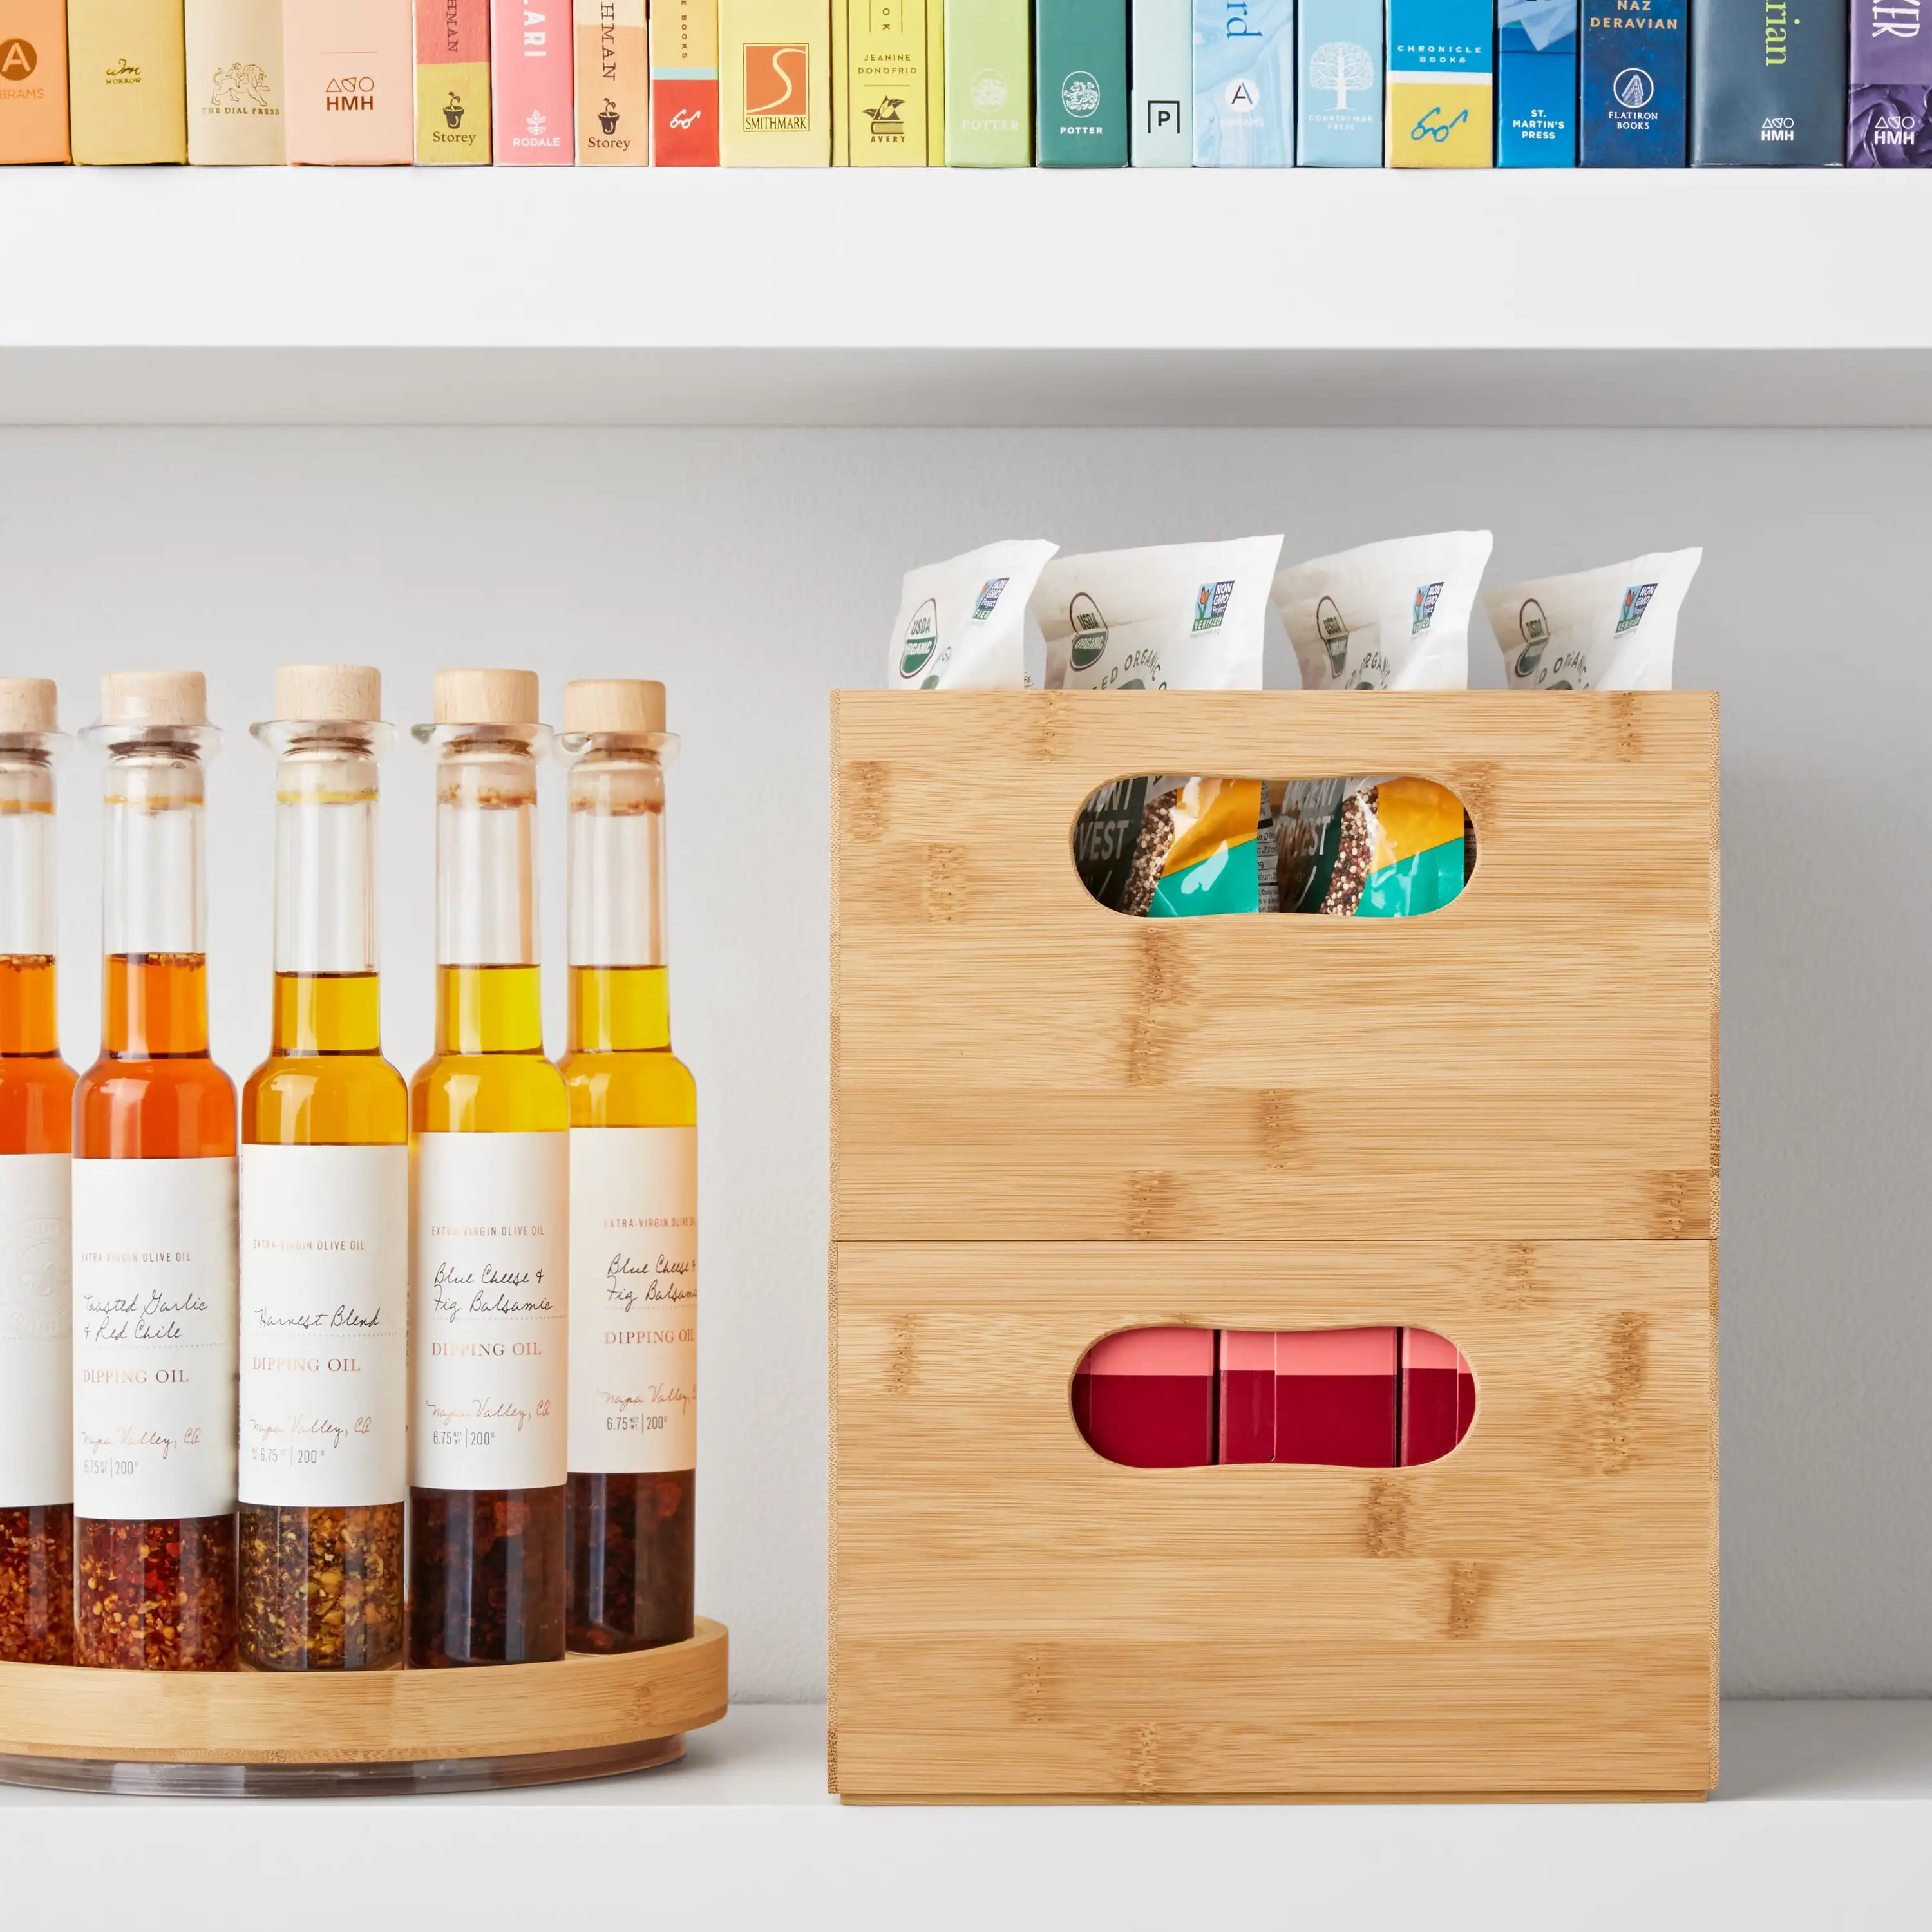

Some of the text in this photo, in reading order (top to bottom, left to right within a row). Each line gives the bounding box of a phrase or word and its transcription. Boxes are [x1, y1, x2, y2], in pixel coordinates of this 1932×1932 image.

[1617, 1, 1651, 11] NAZ
[523, 0, 547, 57] ARI
[1590, 17, 1678, 30] DERAVIAN
[1765, 0, 1801, 66] rian
[601, 1, 616, 80] HMAN
[1397, 44, 1482, 53] CHRONICLE
[858, 66, 918, 75] DONOFRIO
[1231, 82, 1253, 104] A
[326, 95, 374, 111] HMH
[252, 107, 280, 115] PRESS
[1157, 110, 1171, 126] P
[1531, 109, 1546, 118] ST.
[1609, 111, 1658, 120] FLATIRON
[746, 117, 806, 129] SMITHMARK
[961, 119, 1019, 131] POTTER
[1513, 120, 1565, 129] MARTIN'S
[1617, 121, 1650, 130] BOOKS
[1060, 126, 1103, 135] POTTER
[1522, 131, 1556, 140] PRESS
[1761, 129, 1794, 141] HMH
[432, 131, 477, 146] Storey
[513, 137, 561, 147] RODALE
[587, 137, 630, 151] Storey
[1874, 131, 1915, 145] HMH
[1215, 583, 1233, 594] NON
[1639, 585, 1656, 596] NON
[1213, 594, 1229, 605] GMO
[911, 617, 931, 636] USDA
[1077, 613, 1100, 630] USDA
[1195, 616, 1222, 630] VERIFIED
[1074, 636, 1104, 650] ORGANIC
[1074, 820, 1130, 861] VEST
[501, 1226, 528, 1236] OLIVE
[531, 1226, 544, 1236] OIL
[317, 1240, 345, 1251] OLIVE
[350, 1240, 365, 1251] OIL
[143, 1252, 171, 1262] OLIVE
[176, 1252, 191, 1262] OIL
[607, 1253, 650, 1276] Blue
[656, 1253, 690, 1276] Cheese
[434, 1262, 474, 1285] Blue
[482, 1264, 530, 1287] Cheese
[607, 1275, 638, 1313] Fig
[84, 1289, 208, 1318] Toasted Garlic
[433, 1284, 553, 1323] Fig Balsamic
[254, 1304, 381, 1329] Harvest Blend
[95, 1316, 128, 1342] Red
[135, 1318, 182, 1340] Chile
[605, 1329, 696, 1344] DIPPING OIL
[431, 1341, 542, 1356] DIPPING OIL
[252, 1356, 361, 1371] DIPPING OIL
[82, 1369, 189, 1383] DIPPING OIL
[536, 1399, 551, 1417] CA
[354, 1416, 372, 1434] CA
[607, 1417, 628, 1430] 6.75
[433, 1430, 451, 1444] 6.75
[260, 1448, 278, 1462] 6.75
[298, 1450, 317, 1463] 200
